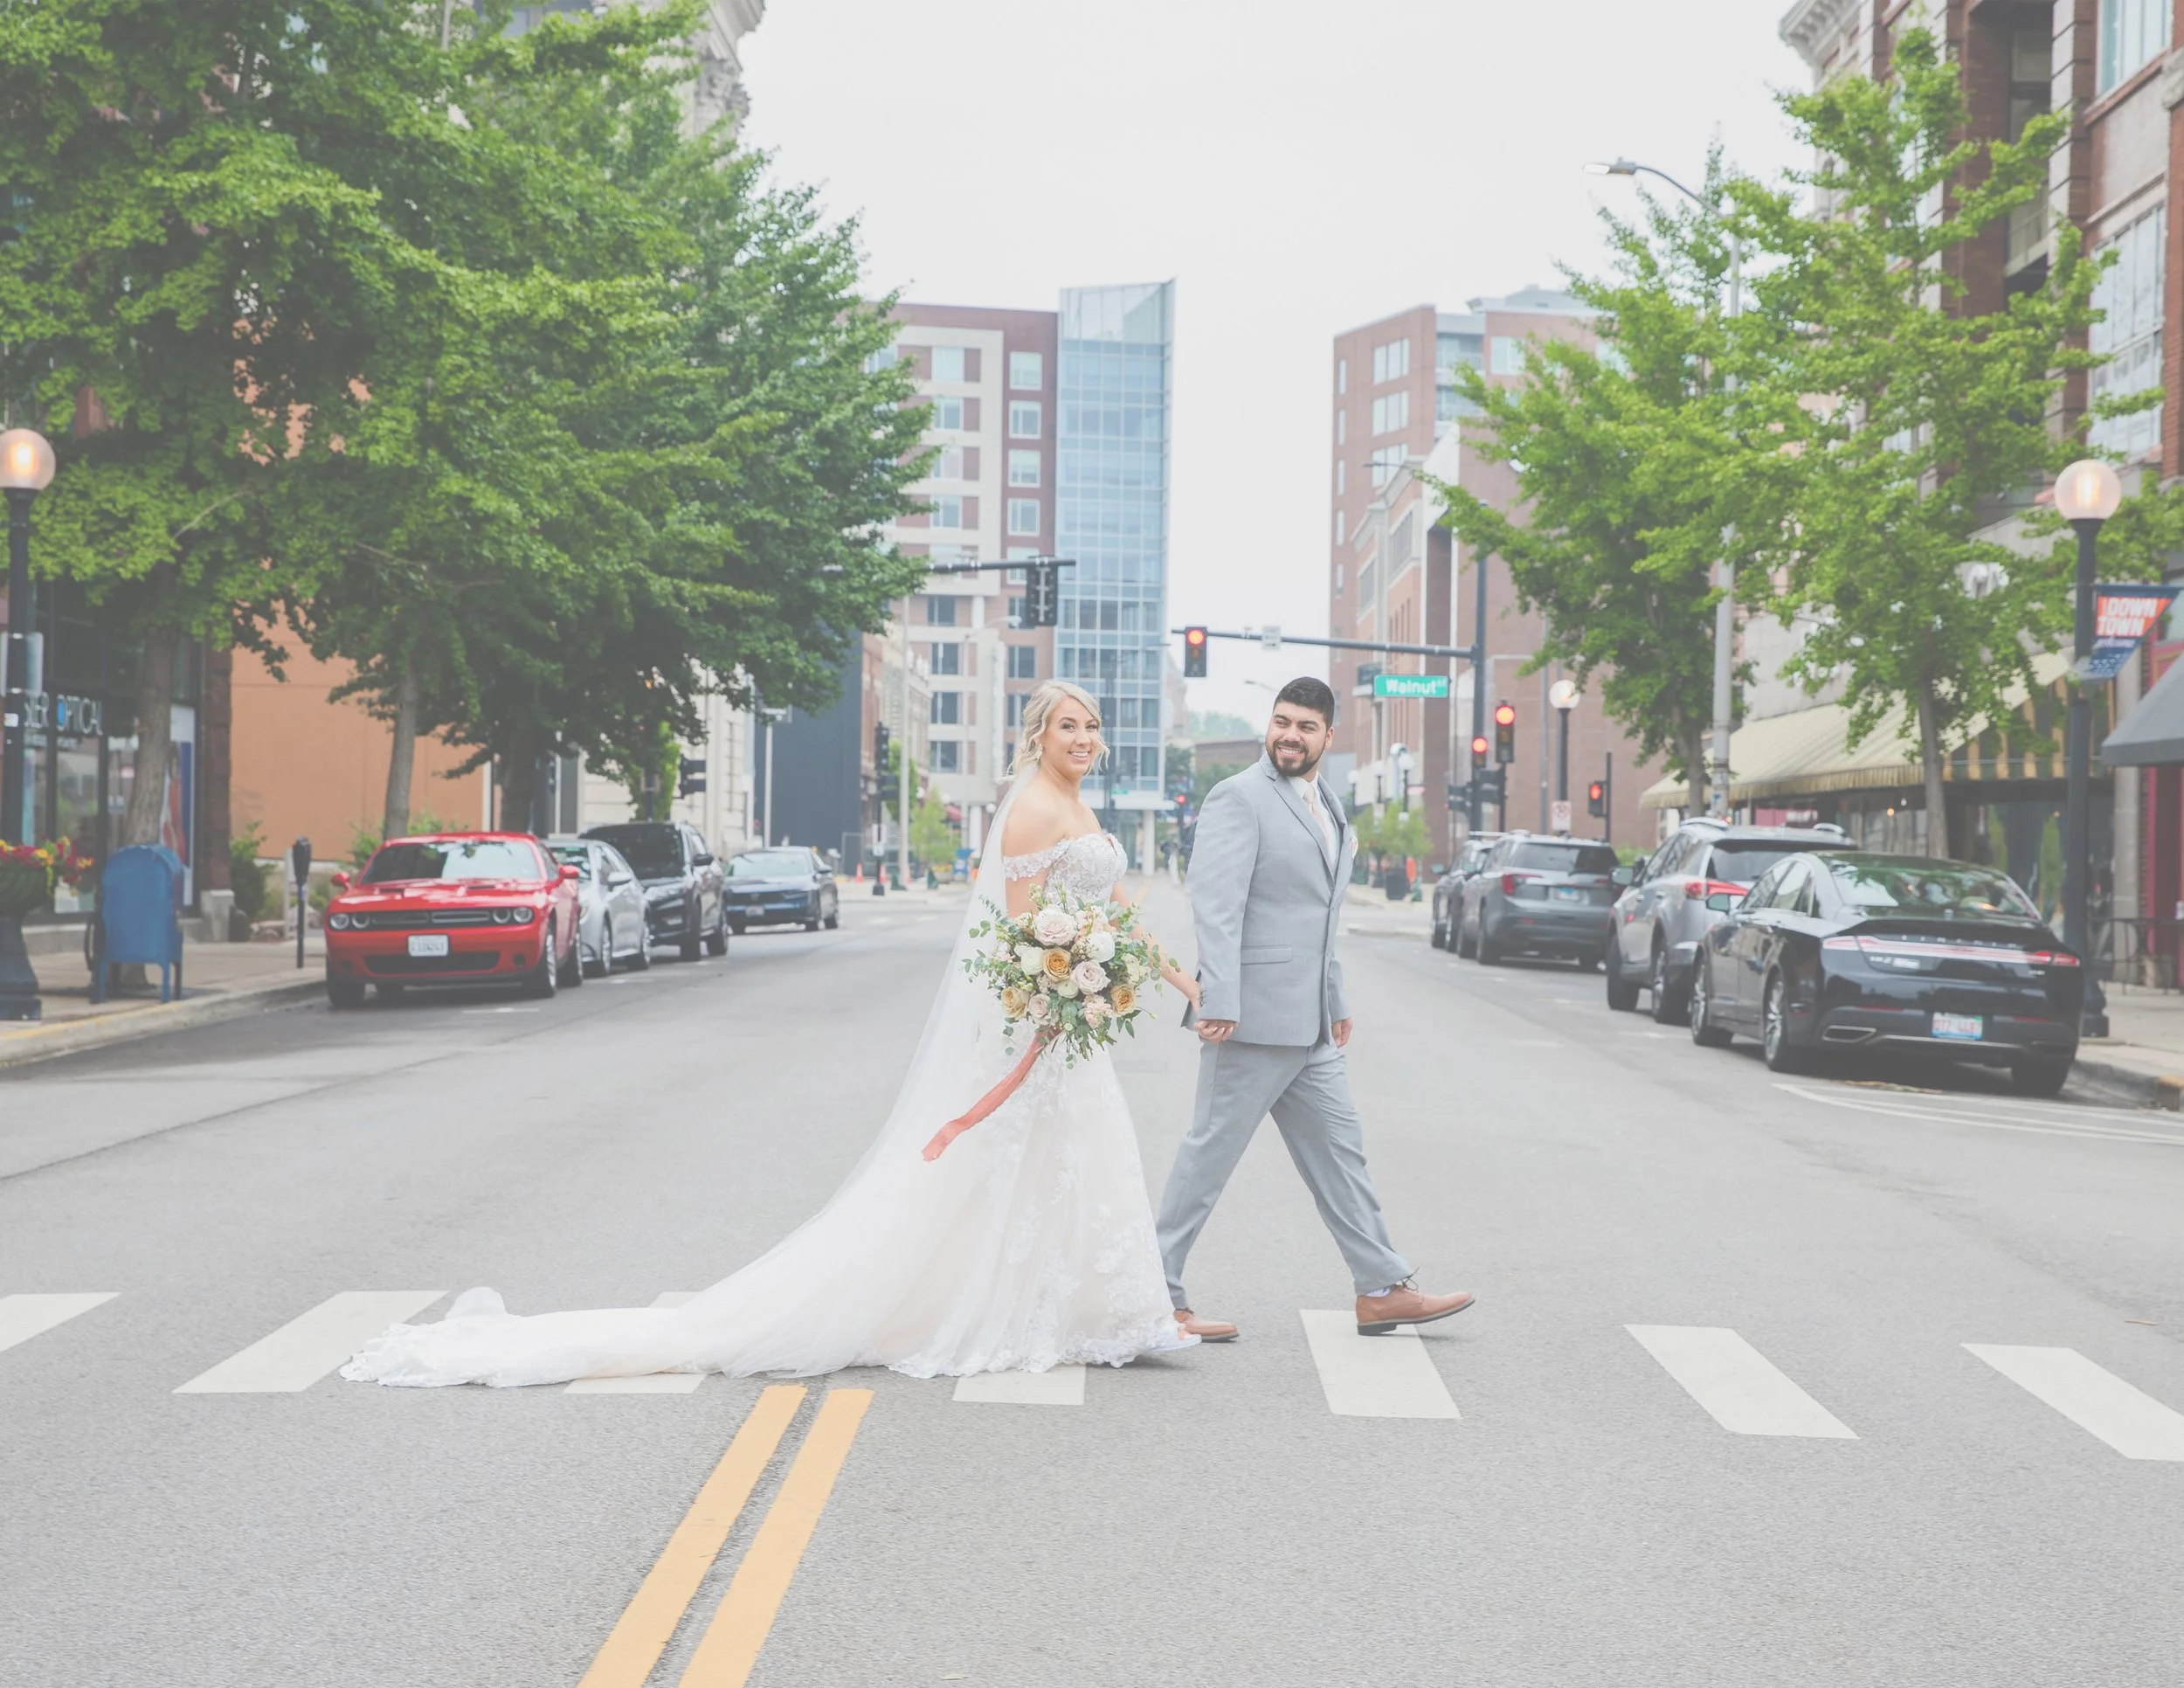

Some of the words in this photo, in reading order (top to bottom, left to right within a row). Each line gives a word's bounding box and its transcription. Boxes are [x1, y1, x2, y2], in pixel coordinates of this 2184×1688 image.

[2108, 598, 2157, 617] DOWN
[2098, 616, 2145, 636] TOWN
[1386, 678, 1436, 695] Walnut
